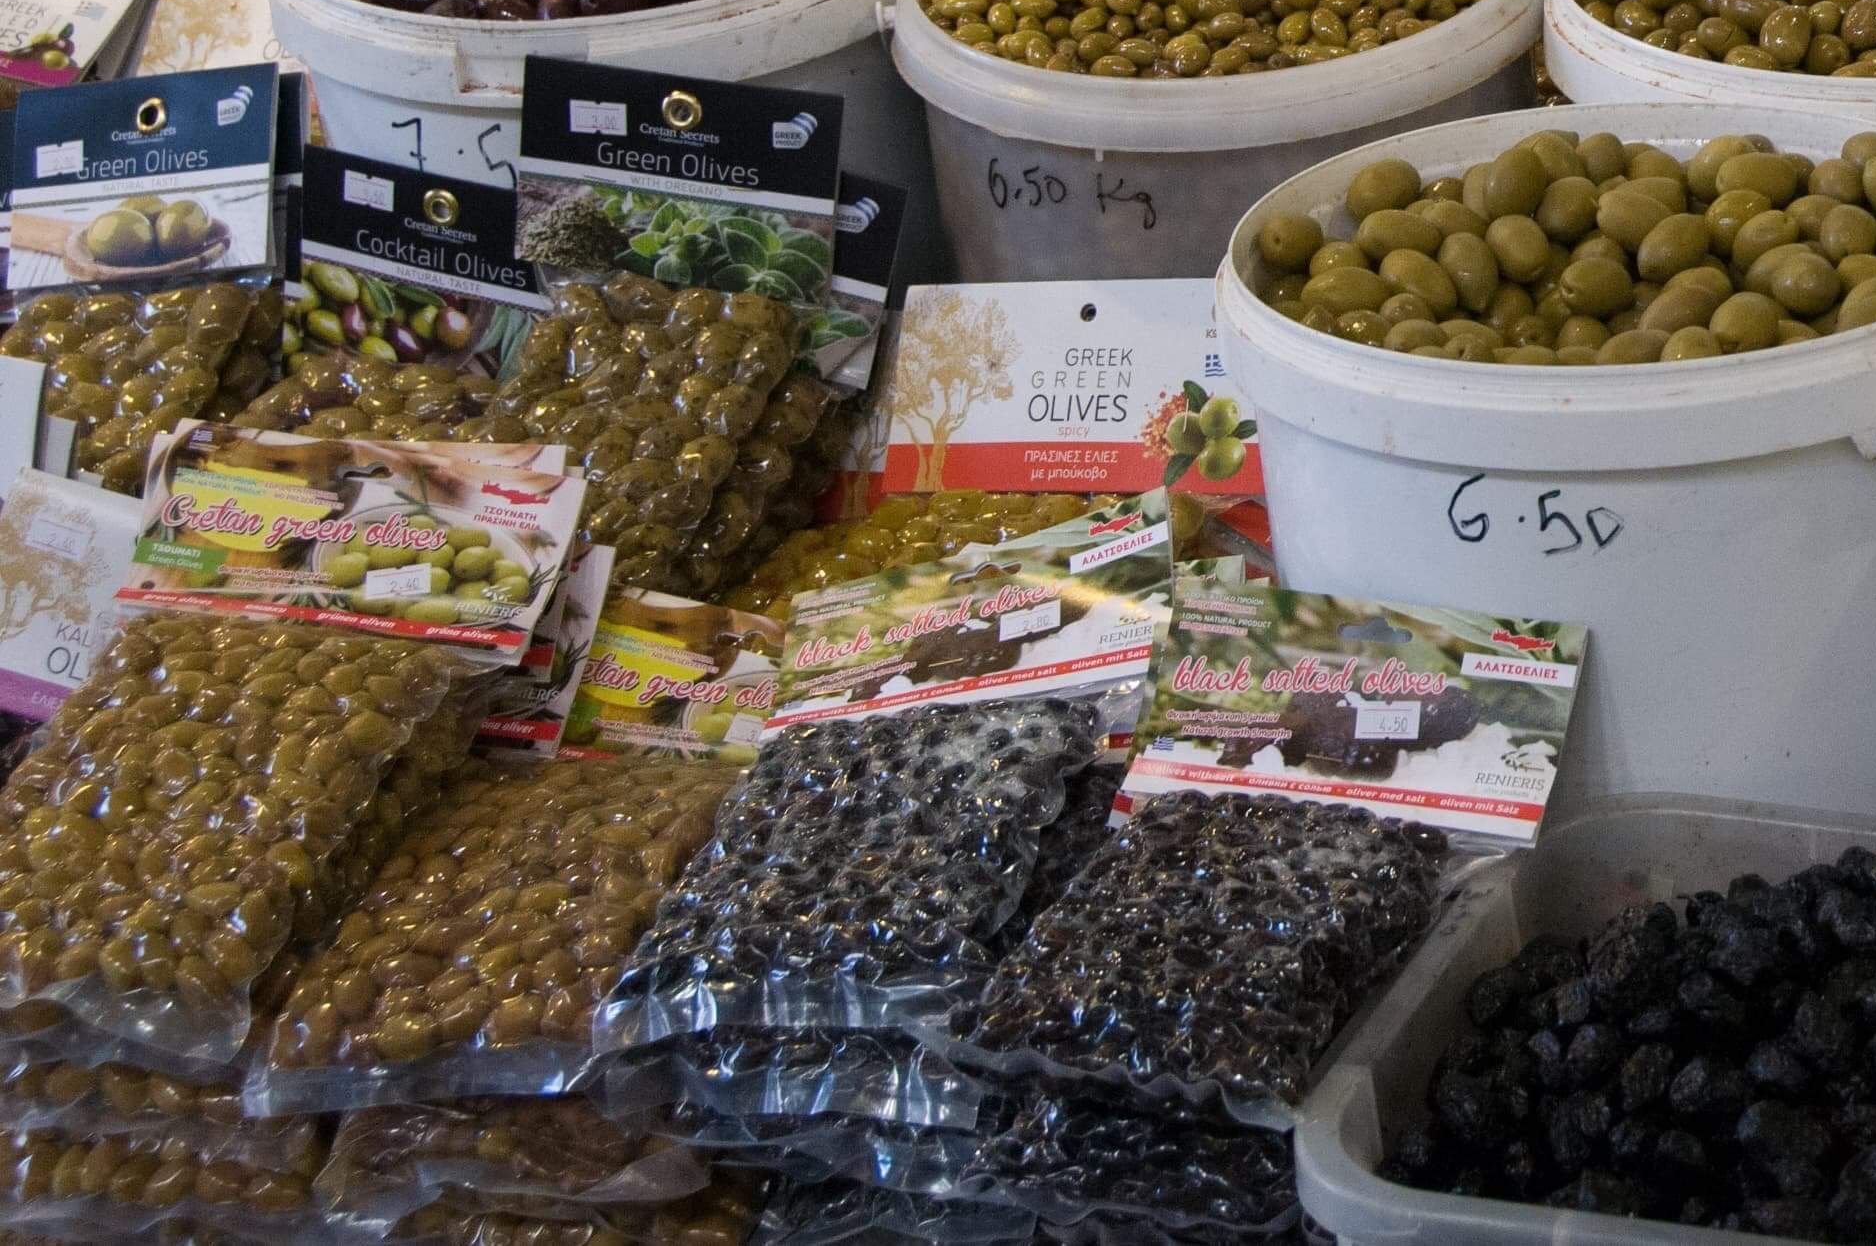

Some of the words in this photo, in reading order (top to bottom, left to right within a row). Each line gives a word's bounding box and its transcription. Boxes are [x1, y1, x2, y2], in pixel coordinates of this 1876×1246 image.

[639, 123, 677, 138] Cretan
[680, 130, 720, 144] Secrets
[76, 157, 137, 181] Green
[145, 148, 209, 171] Olives
[597, 141, 671, 174] Green
[681, 153, 760, 186] Olives
[631, 174, 661, 187] WITH
[665, 179, 723, 197] OREGANO
[988, 158, 1067, 209] 6.50
[404, 217, 438, 234] Cretan
[441, 225, 477, 242] Secrets
[355, 229, 446, 271] Cocktail
[455, 253, 527, 288] Olives
[397, 265, 445, 286] NATURAL
[449, 277, 482, 293] TASTE
[1065, 347, 1134, 367] GREEK
[1031, 370, 1132, 389] GREEN
[1028, 393, 1129, 422] OLIVES
[1057, 425, 1090, 438] spicy
[1024, 449, 1080, 463] ΠΡΑΣΙΝΕΣ
[1085, 449, 1118, 463] ΕΛΙΕΣ
[1030, 468, 1045, 480] με
[1048, 465, 1107, 480] μπούκοβο
[161, 493, 264, 535] Cretan
[264, 513, 358, 550] green
[365, 513, 448, 551] olives
[472, 513, 517, 529] ΠΡΑΣΙΝΗ
[518, 519, 541, 532] ΕΛΙΑ
[483, 505, 538, 521] ΤΣΟΥΝΑΤΗ
[1448, 473, 1625, 557] 6.50
[1082, 532, 1154, 566] ΑΛΑΤΣΟΕΛΙΕΣ
[143, 593, 177, 604] green
[455, 601, 524, 619] RENIERIS
[360, 617, 397, 629] oliven
[794, 627, 873, 669] black
[980, 580, 1060, 620] olives
[1204, 614, 1237, 626] NATURAL
[1238, 618, 1273, 629] PRODUCT
[463, 629, 498, 641] oliver
[1099, 625, 1153, 644] RENIER
[1071, 659, 1104, 671] oliven
[1106, 654, 1124, 663] mit
[1126, 649, 1149, 659] Salz
[1474, 660, 1559, 680] ΑΛΑΤΣΟΕΛΙΕΣ
[581, 652, 640, 692] etan
[637, 674, 728, 706] green
[734, 677, 779, 710] oli
[978, 676, 1010, 688] oliver
[1011, 671, 1035, 682] med
[1037, 667, 1057, 677] salt
[1173, 655, 1251, 692] black
[1361, 656, 1448, 696] olives
[1378, 715, 1409, 733] 4.50
[1474, 771, 1546, 792] RENIERIS
[1346, 787, 1378, 799] oliver
[1379, 790, 1403, 801] med
[1404, 792, 1427, 804] salt
[1440, 797, 1473, 810] oliven
[1475, 800, 1494, 811] mit
[1496, 803, 1520, 816] Salz
